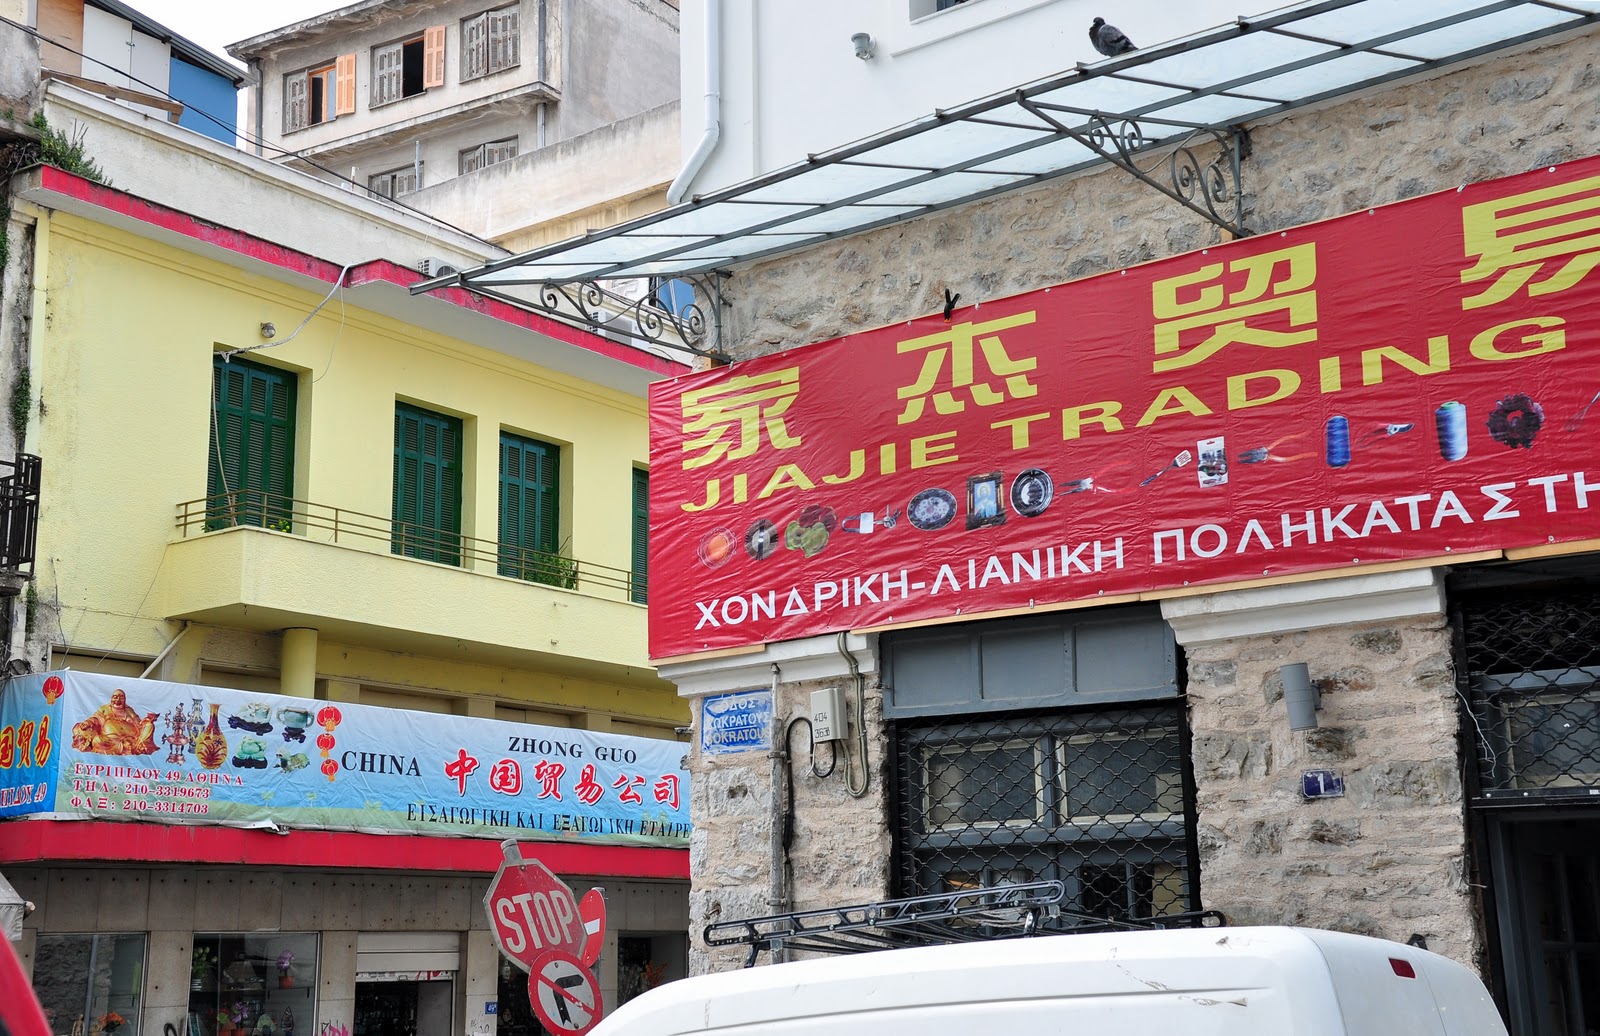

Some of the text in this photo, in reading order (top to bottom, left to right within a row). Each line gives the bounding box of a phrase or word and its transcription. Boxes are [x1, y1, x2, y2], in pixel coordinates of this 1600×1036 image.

[680, 316, 1567, 513] JIAJIE TRADING
[706, 711, 770, 729] ΩΚΡΑΤΟΥΣ
[508, 736, 637, 764] ZHONG GUO
[74, 763, 243, 786] ΕΥΡΙΠΙΔΟΥ 49 ΑΘΗΝΑ
[341, 750, 422, 777] CHINA
[125, 783, 210, 798] 210-3319673
[444, 749, 681, 811] 中国贸易公司
[123, 799, 209, 814] 210-3314703
[516, 812, 544, 830] ΚΑΙ
[496, 889, 575, 954] STOP
